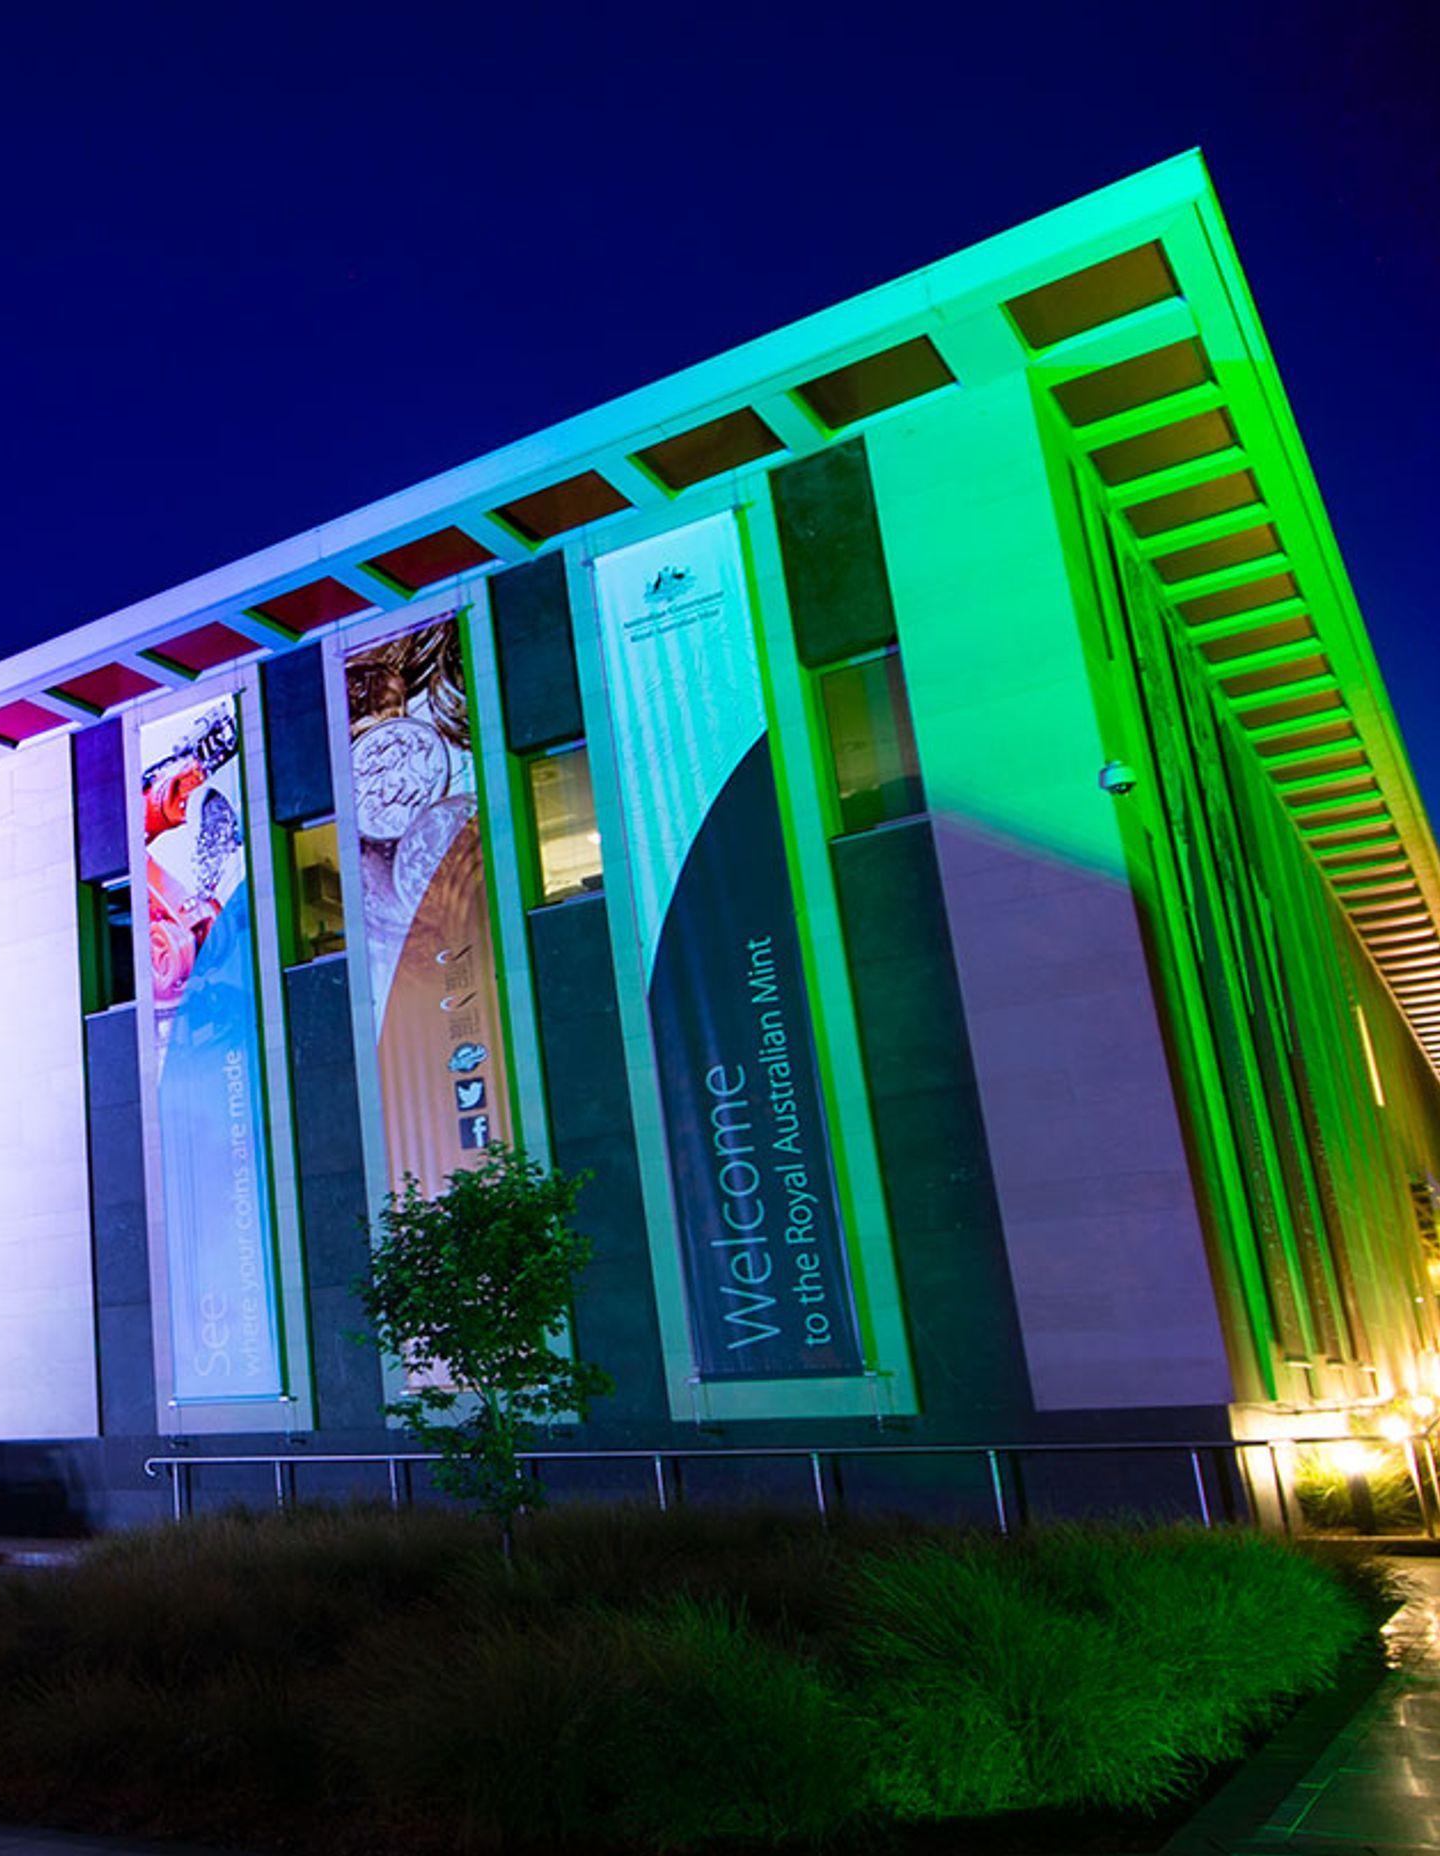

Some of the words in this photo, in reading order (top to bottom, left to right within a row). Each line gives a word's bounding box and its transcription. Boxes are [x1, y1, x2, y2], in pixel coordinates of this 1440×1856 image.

[747, 935, 779, 1003] Mint
[222, 1049, 244, 1118] made
[756, 1010, 802, 1154] Australian
[229, 1123, 248, 1161] are
[231, 1166, 253, 1231] coins
[705, 1064, 781, 1349] Welcome
[773, 1163, 820, 1244] Royal
[237, 1236, 260, 1291] your
[792, 1252, 825, 1305] the
[194, 1292, 231, 1377] See
[238, 1298, 261, 1377] where
[805, 1313, 831, 1346] to
